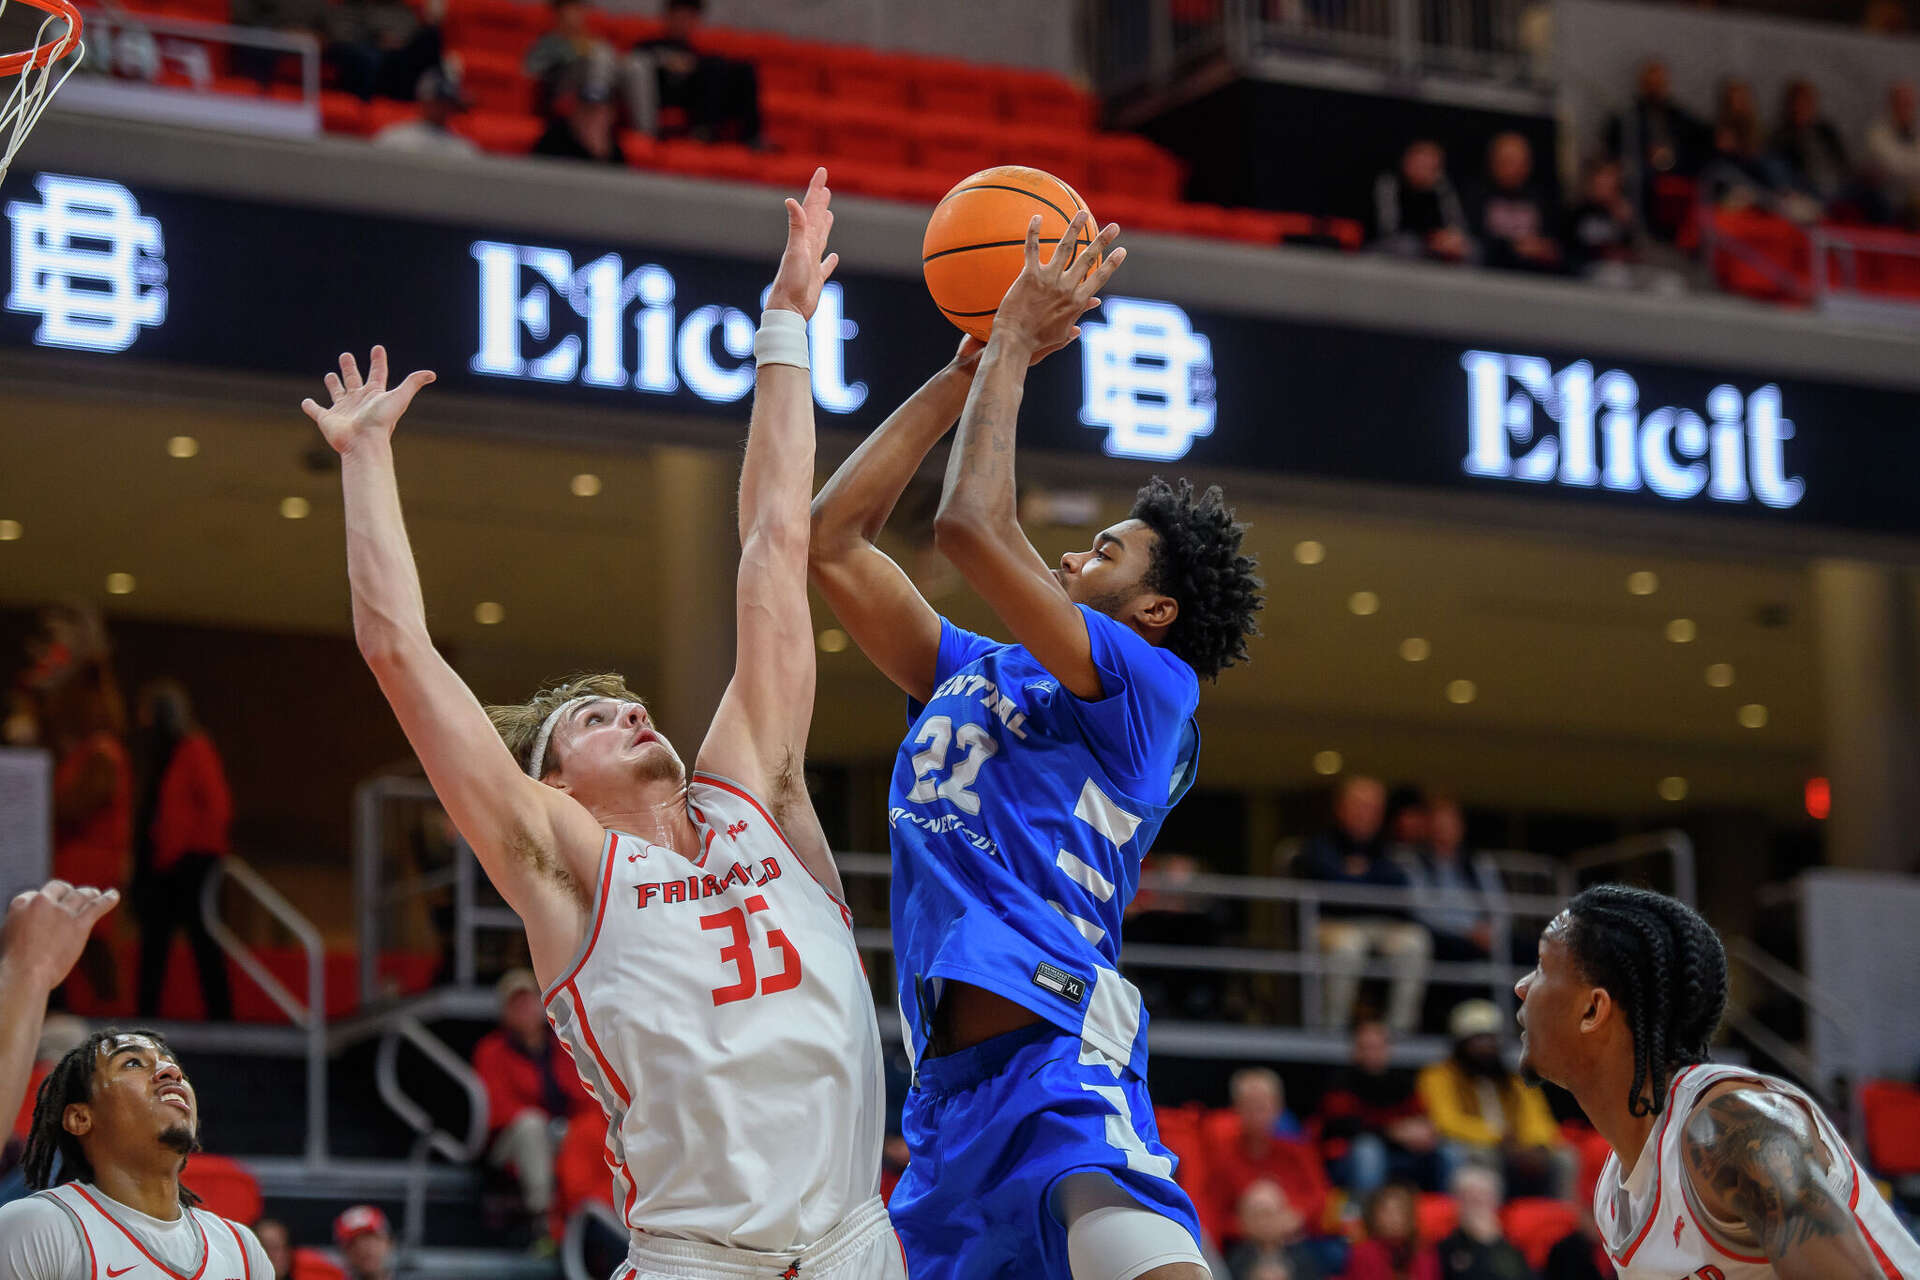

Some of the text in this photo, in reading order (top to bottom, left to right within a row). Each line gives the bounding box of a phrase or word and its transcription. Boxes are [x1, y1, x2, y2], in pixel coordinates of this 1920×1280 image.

[469, 240, 869, 414] Elict
[1459, 350, 1806, 509] Elicit
[930, 674, 1028, 740] ENTRAL
[905, 715, 998, 816] 22
[1066, 982, 1079, 996] XL
